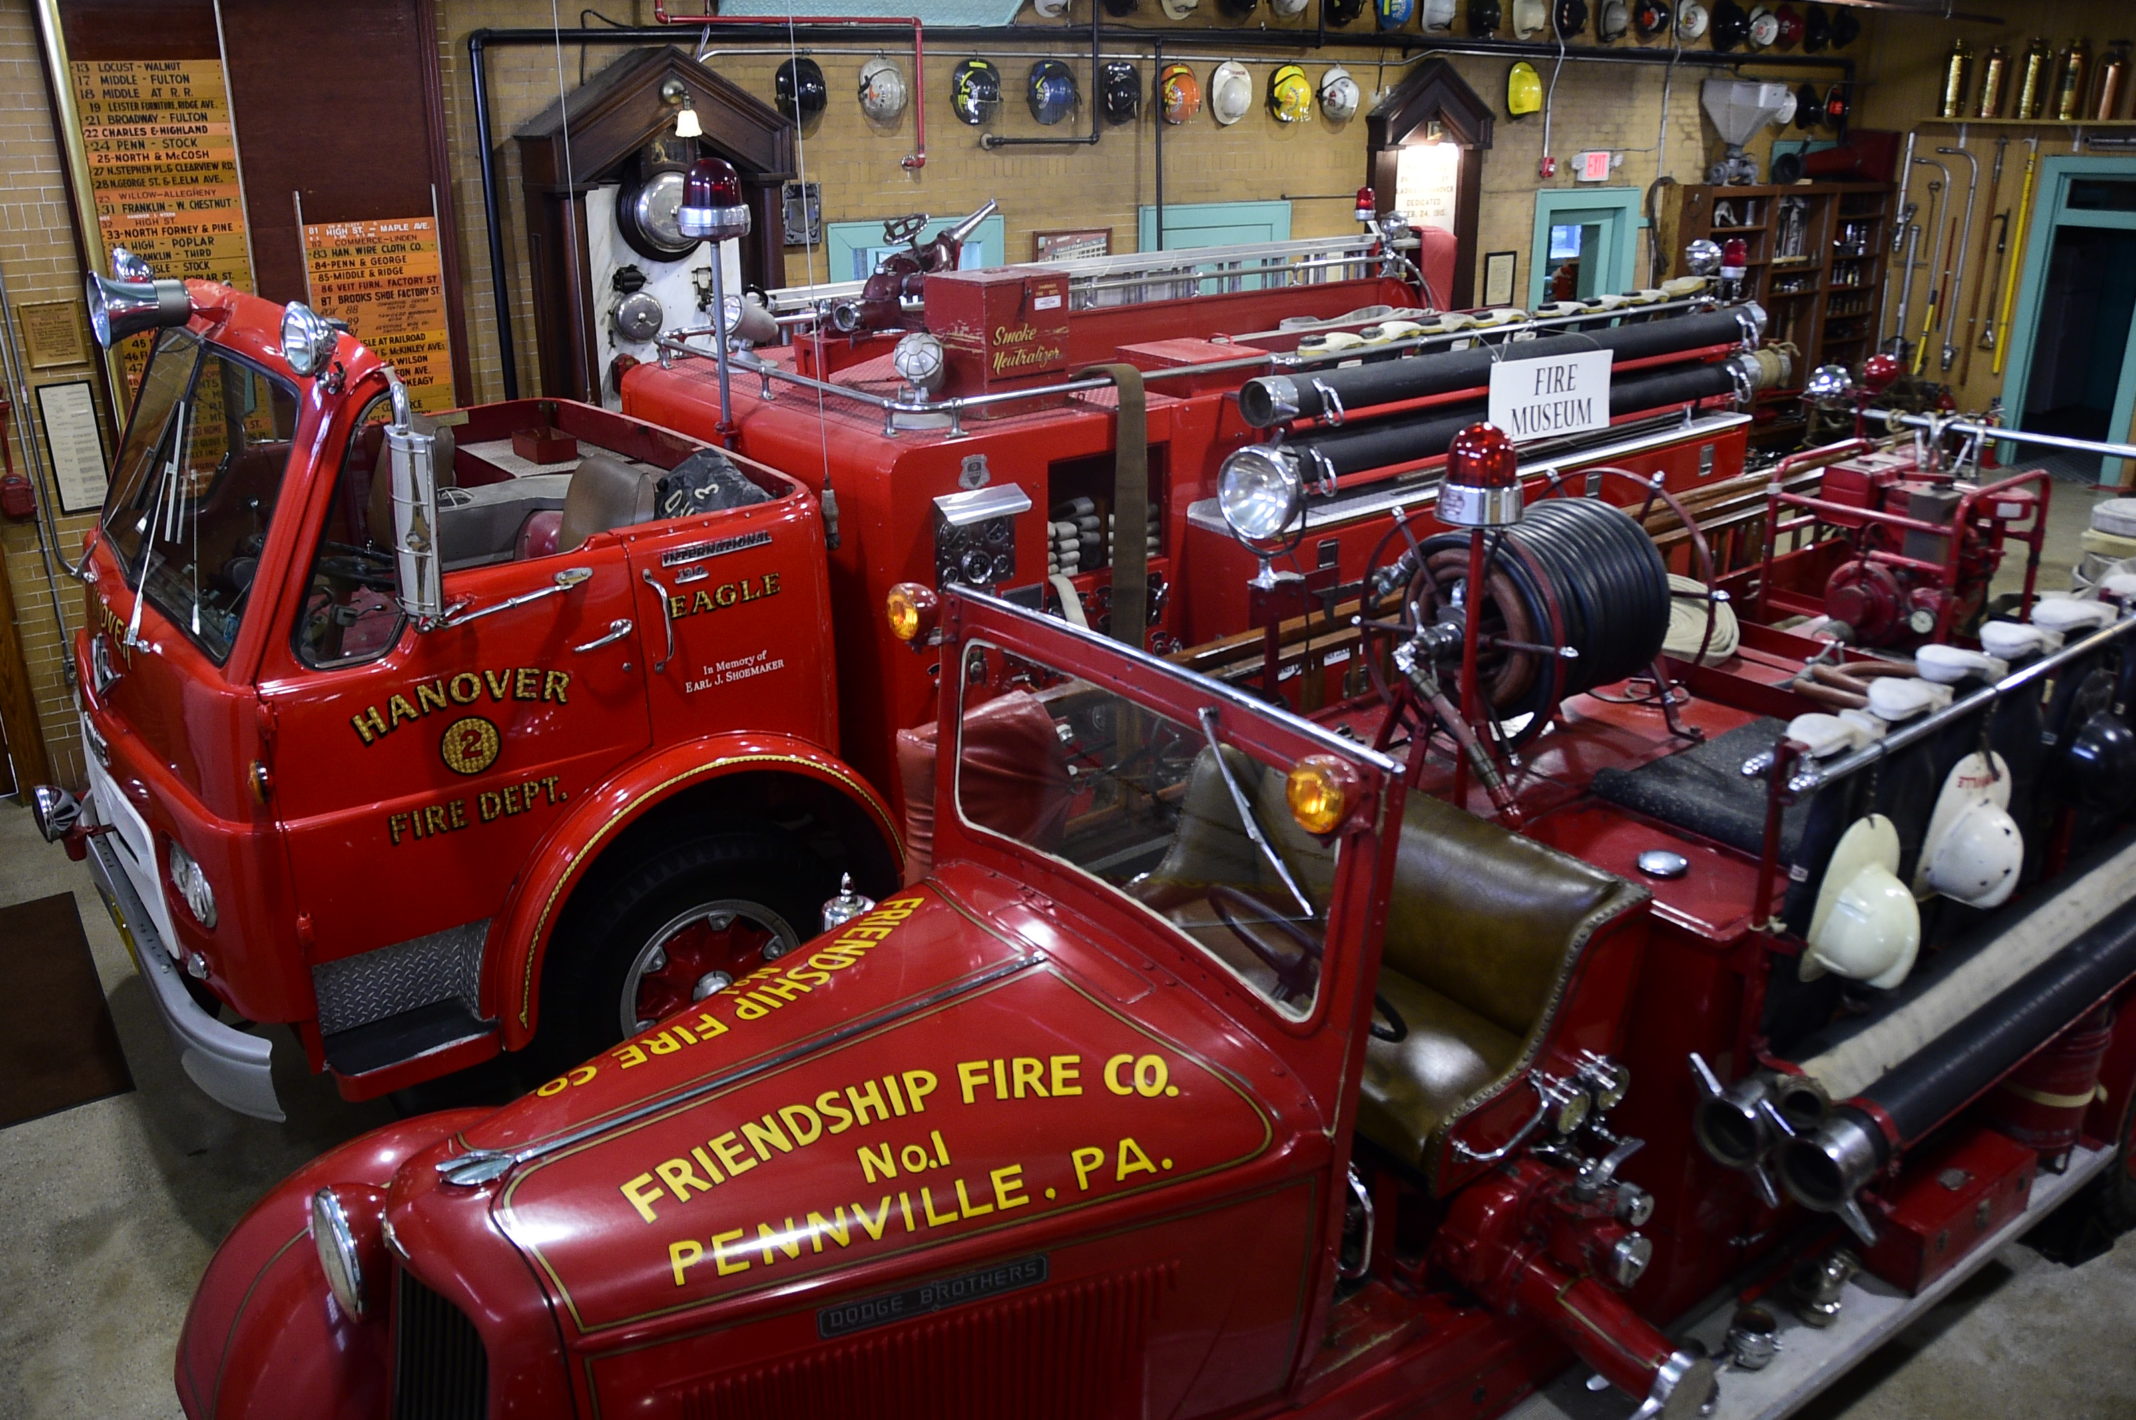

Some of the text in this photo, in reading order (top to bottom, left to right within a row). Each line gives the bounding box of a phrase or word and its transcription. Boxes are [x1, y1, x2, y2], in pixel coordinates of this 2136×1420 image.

[76, 62, 181, 73] 13 LOCUST WALNUT
[78, 73, 191, 86] 17 MIDDLE FULTON
[80, 88, 95, 100] 18
[102, 88, 141, 99] MIDDLE
[151, 87, 162, 98] AT
[89, 102, 101, 113] 19
[108, 101, 139, 112] LEISTER
[200, 99, 218, 110] AVE.
[85, 112, 208, 126] 21 BROADWAY FULTON
[84, 128, 99, 138] 22
[102, 126, 147, 138] CHARLES
[160, 125, 209, 135] HIGHLAND
[90, 138, 198, 152] 24 PENN STOCK
[154, 152, 162, 161] &
[166, 150, 210, 160] McCOSH
[93, 167, 104, 177] 27
[175, 161, 219, 172] CLEARVIEW
[222, 161, 236, 171] RD.
[1587, 154, 1609, 177] EXIT
[95, 180, 109, 190] 28
[149, 177, 161, 186] ST.
[203, 174, 224, 183] AVE.
[101, 204, 115, 215] 31
[122, 200, 166, 214] FRANKLIN
[189, 198, 232, 210] CHESTNUT
[135, 218, 159, 227] HIGH
[161, 224, 198, 236] FORNEY
[201, 224, 209, 233] &
[211, 222, 234, 232] PINE
[308, 227, 319, 235] 81
[326, 227, 348, 237] HIGH
[380, 223, 409, 233] MAPLE
[413, 222, 430, 230] AVE.
[131, 240, 155, 251] HIGH
[171, 237, 215, 249] POPLAR
[313, 242, 423, 259] 83 HAN. WIRE CLOTH CO.
[183, 248, 212, 259] THIRD
[359, 258, 367, 267] &
[370, 255, 407, 266] GEORGE
[183, 261, 211, 272] STOCK
[369, 269, 376, 278] &
[377, 266, 404, 277] RIDGE
[321, 284, 334, 294] 86
[336, 282, 355, 292] VEIT
[358, 280, 382, 290] FURN.
[387, 276, 424, 288] FACTORY
[321, 296, 332, 307] 87
[338, 292, 372, 305] BROOKS
[374, 289, 395, 301] SHOE
[397, 287, 430, 299] FACTORY
[378, 336, 388, 346] AT
[388, 333, 426, 344] RAILROAD
[992, 323, 1038, 347] Smoke
[131, 338, 147, 348] 45
[124, 351, 138, 361] 46
[396, 355, 428, 366] WILSON
[992, 345, 1060, 376] Neutralizer
[128, 363, 143, 373] 47
[406, 377, 434, 388] KEAGY
[1534, 363, 1578, 397] FIRE
[1511, 397, 1593, 437] MUSEUM
[669, 573, 781, 620] EAGLE
[703, 649, 768, 676] In Memory of
[685, 658, 785, 693] EARL J. SHOEMAKER
[351, 667, 570, 745] HANOVER
[460, 729, 483, 760] 2
[390, 776, 568, 843] FIRE DEPT.
[735, 897, 925, 1021] FRIENDSHIP
[611, 1012, 730, 1070] FIRE
[619, 1053, 1180, 1225] FRIENDSHIP FIRE CO.
[1071, 1137, 1173, 1191] PA.
[829, 1260, 1038, 1329] DODGE BROTHERS
